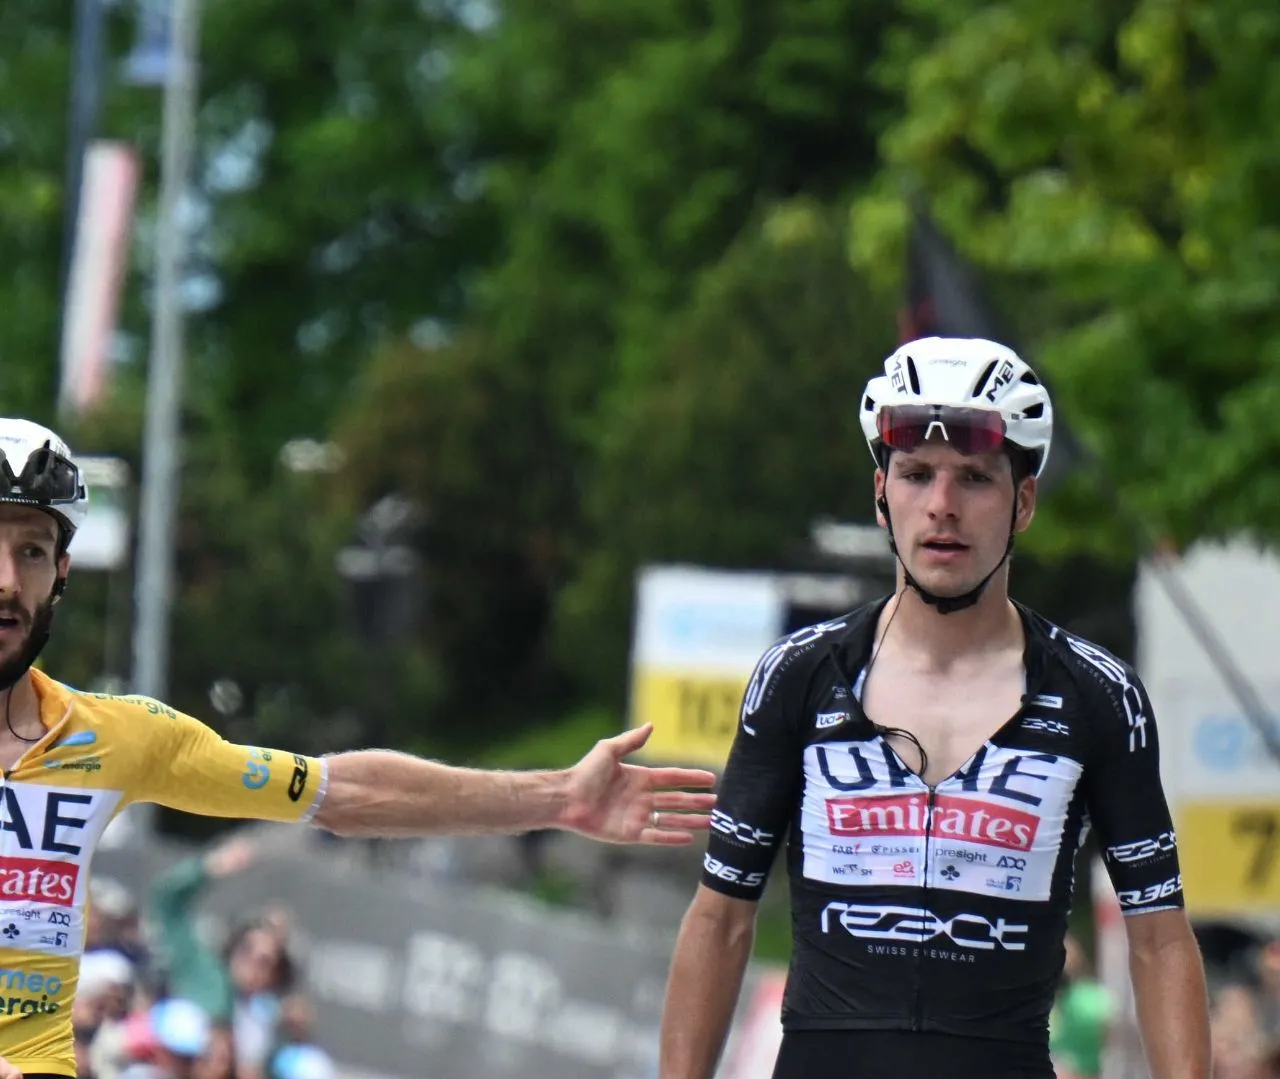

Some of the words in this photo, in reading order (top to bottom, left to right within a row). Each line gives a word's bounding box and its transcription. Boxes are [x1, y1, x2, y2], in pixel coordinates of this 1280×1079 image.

[831, 797, 1032, 848] Emirates
[934, 847, 988, 864] presight
[866, 944, 907, 957] SWISS
